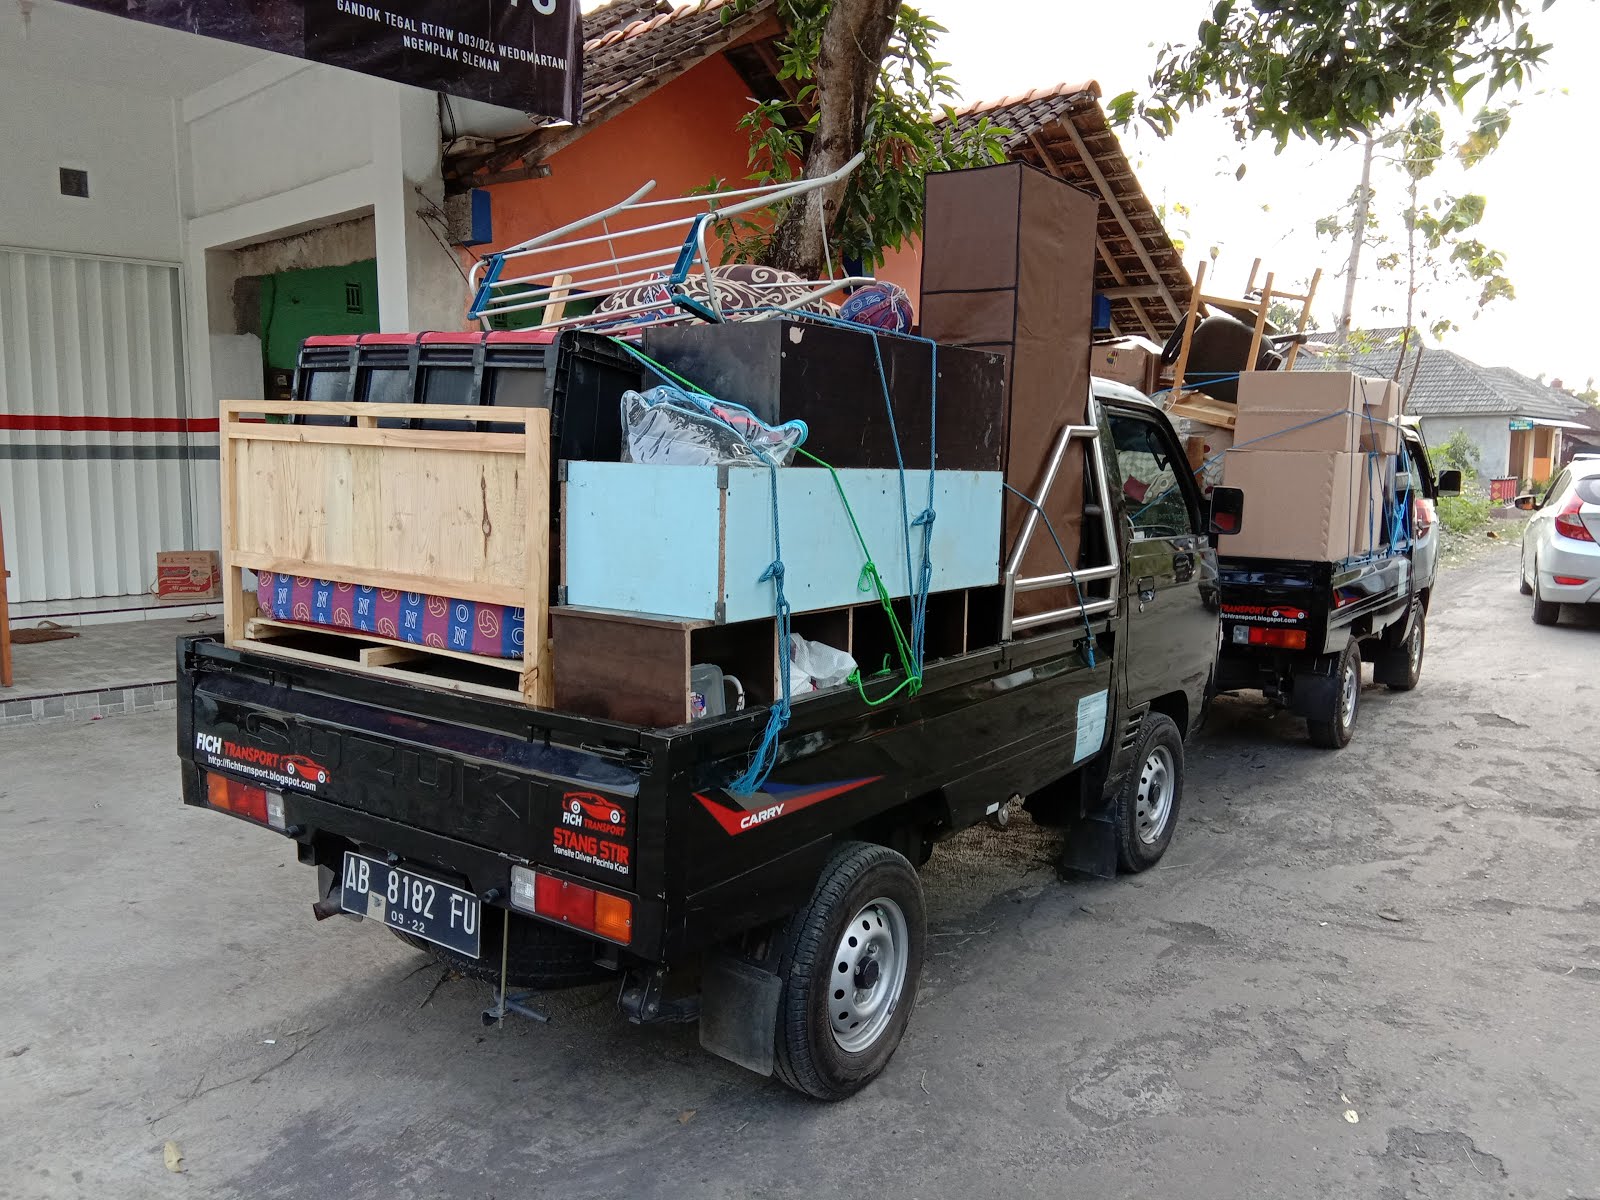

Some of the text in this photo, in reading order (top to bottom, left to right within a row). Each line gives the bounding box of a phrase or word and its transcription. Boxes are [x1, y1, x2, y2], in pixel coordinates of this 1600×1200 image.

[337, 0, 568, 72] GANDOK TEGAL RT/RW 003/024 WEDOMARTANI
[403, 35, 501, 73] NGEMPLAK SLEMAN
[196, 732, 280, 768] FICH TRANSPORT
[562, 811, 626, 837] FICH TRANSPORT
[741, 803, 785, 829] CARRY
[553, 827, 629, 865] STANG STIR
[575, 851, 593, 863] Driver
[614, 862, 629, 875] Kopi
[345, 856, 476, 935] AB 8182 FU
